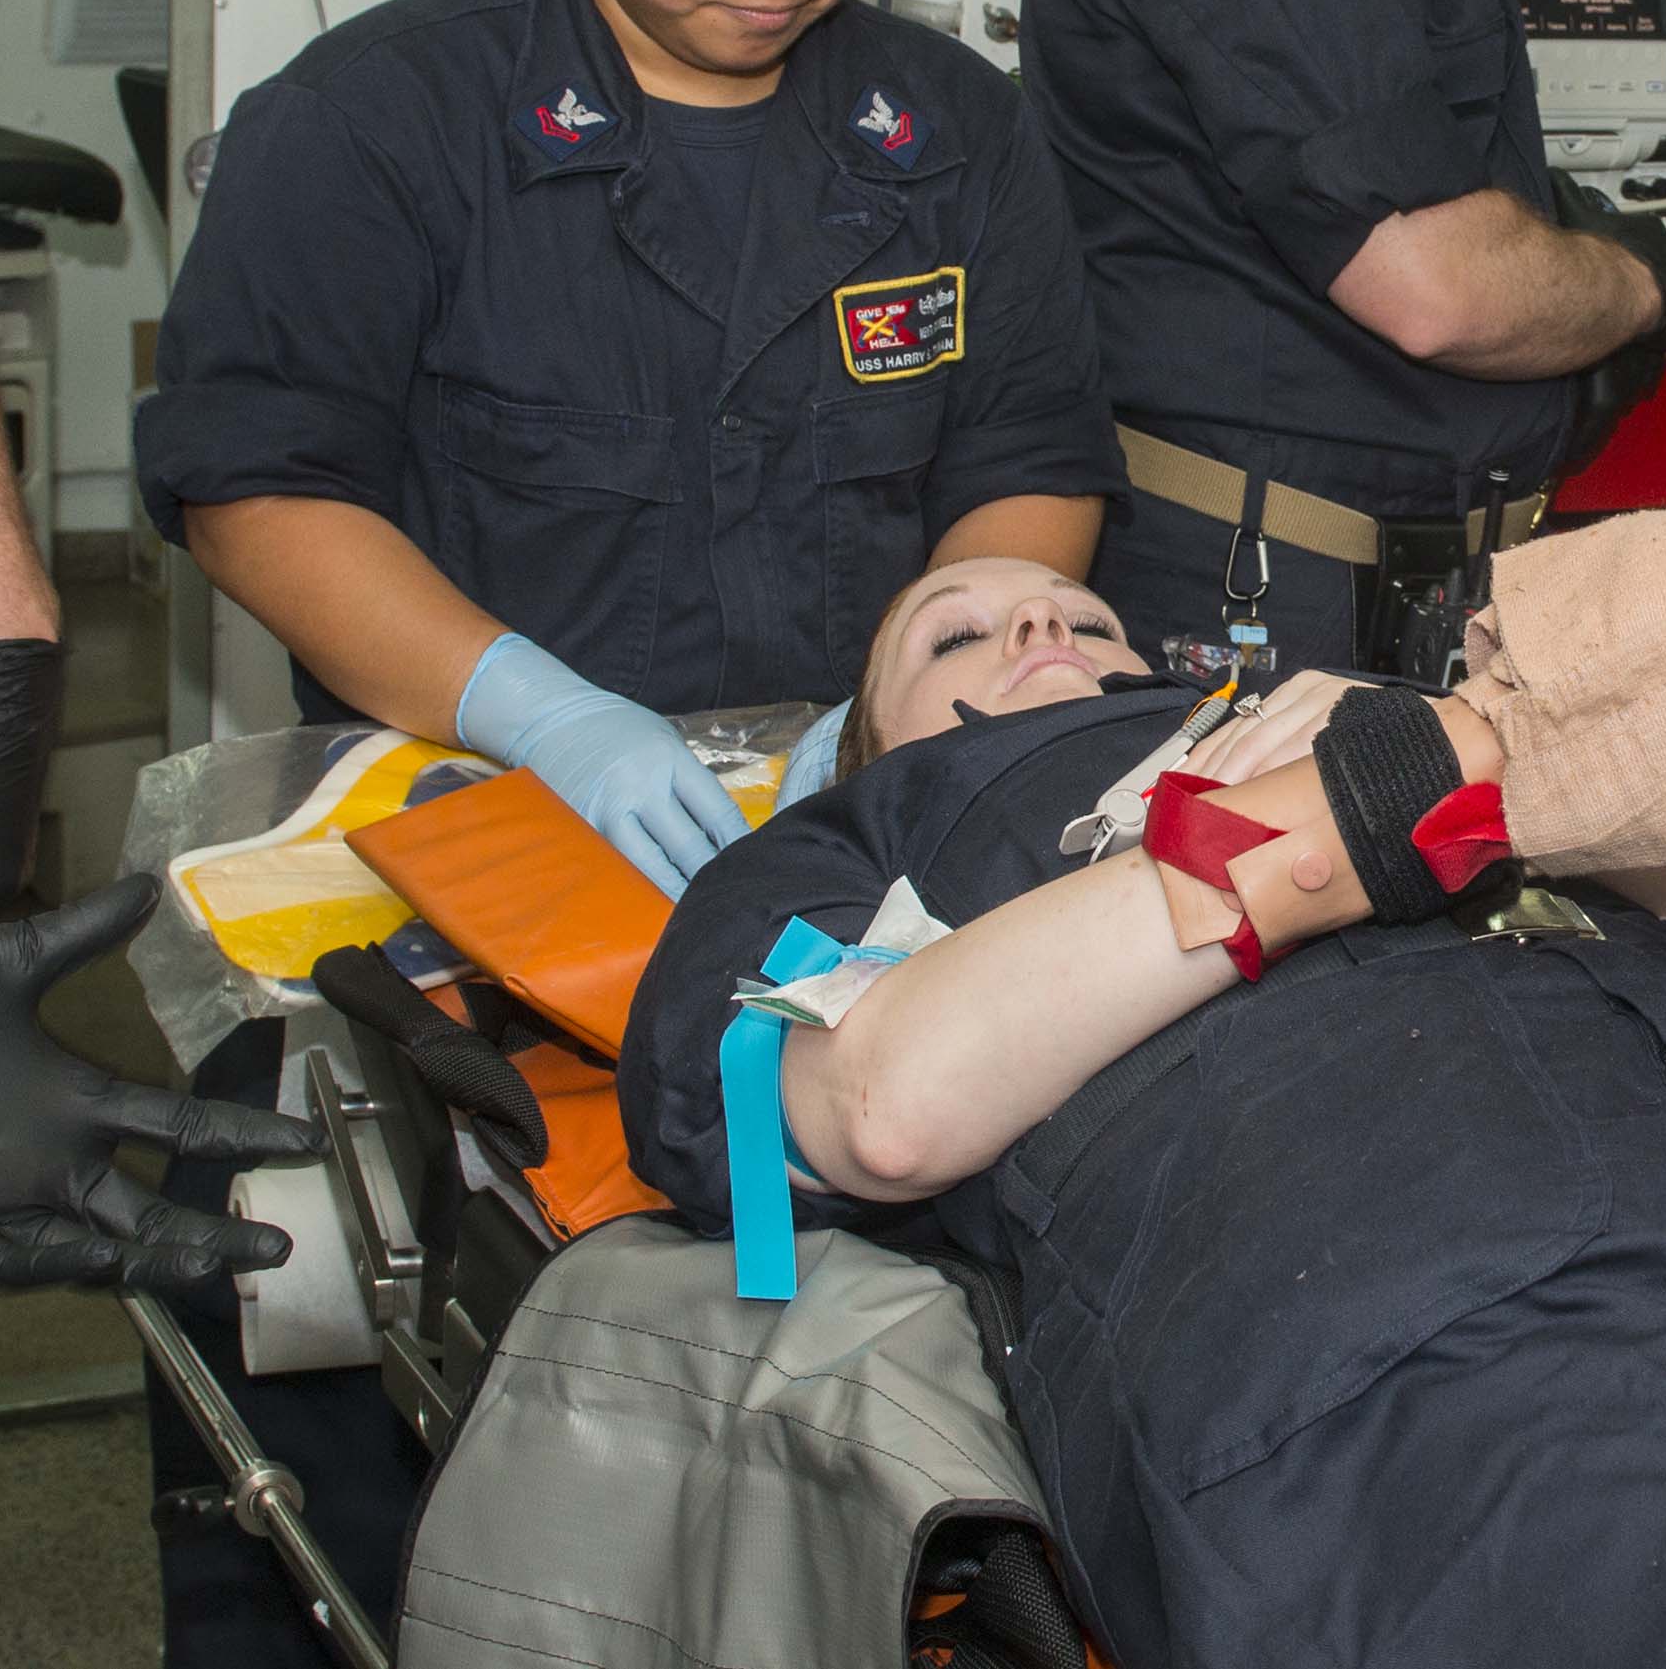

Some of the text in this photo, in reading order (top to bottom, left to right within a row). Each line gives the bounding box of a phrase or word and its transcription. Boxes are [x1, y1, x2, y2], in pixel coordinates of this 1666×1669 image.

[856, 307, 883, 320] GIVE
[869, 336, 905, 350] HELL
[855, 352, 926, 372] USS HARRY
